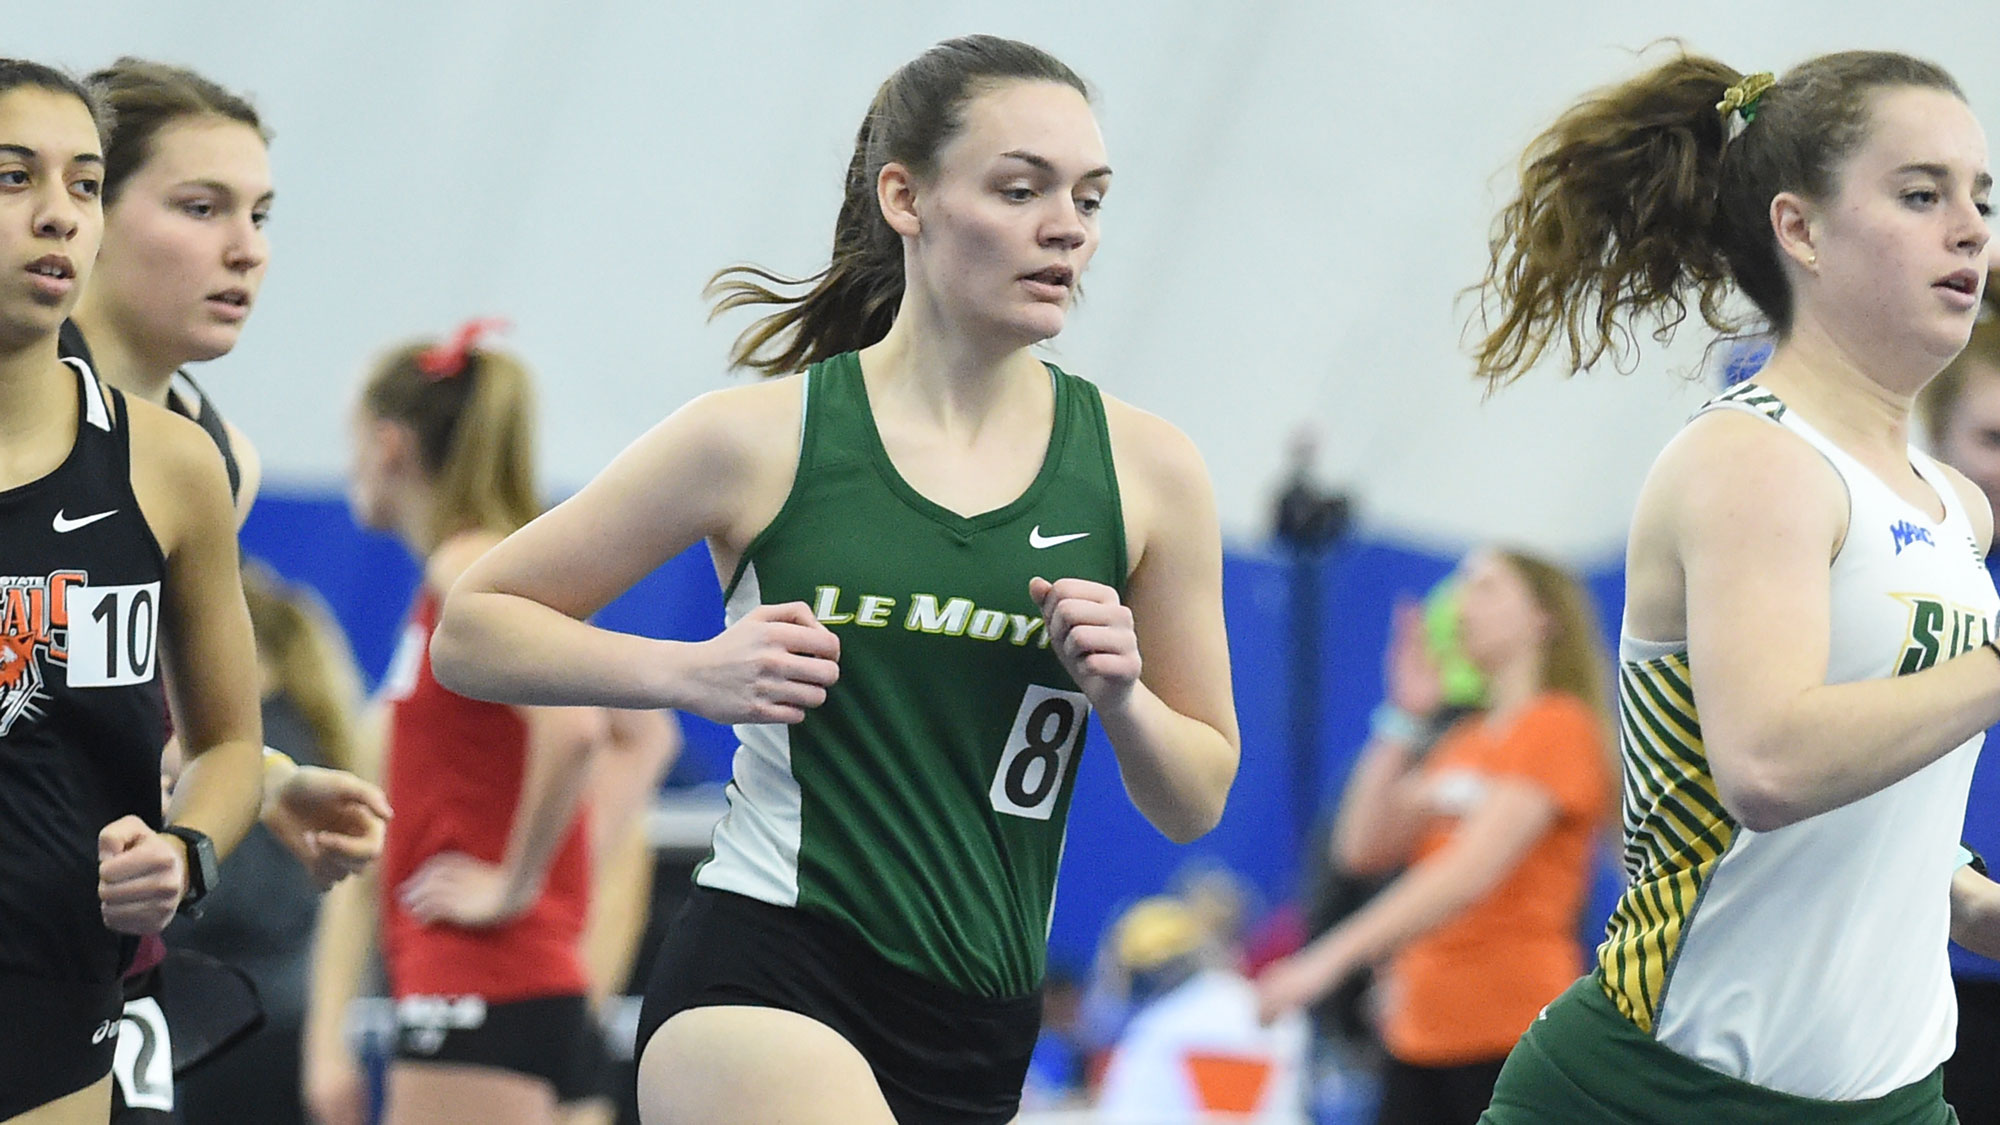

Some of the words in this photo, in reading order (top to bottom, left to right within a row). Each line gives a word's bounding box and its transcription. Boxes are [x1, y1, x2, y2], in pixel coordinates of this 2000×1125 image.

[0, 570, 88, 666] ALS
[91, 589, 153, 678] 10
[904, 594, 1051, 648] MOY
[1004, 697, 1075, 808] 8
